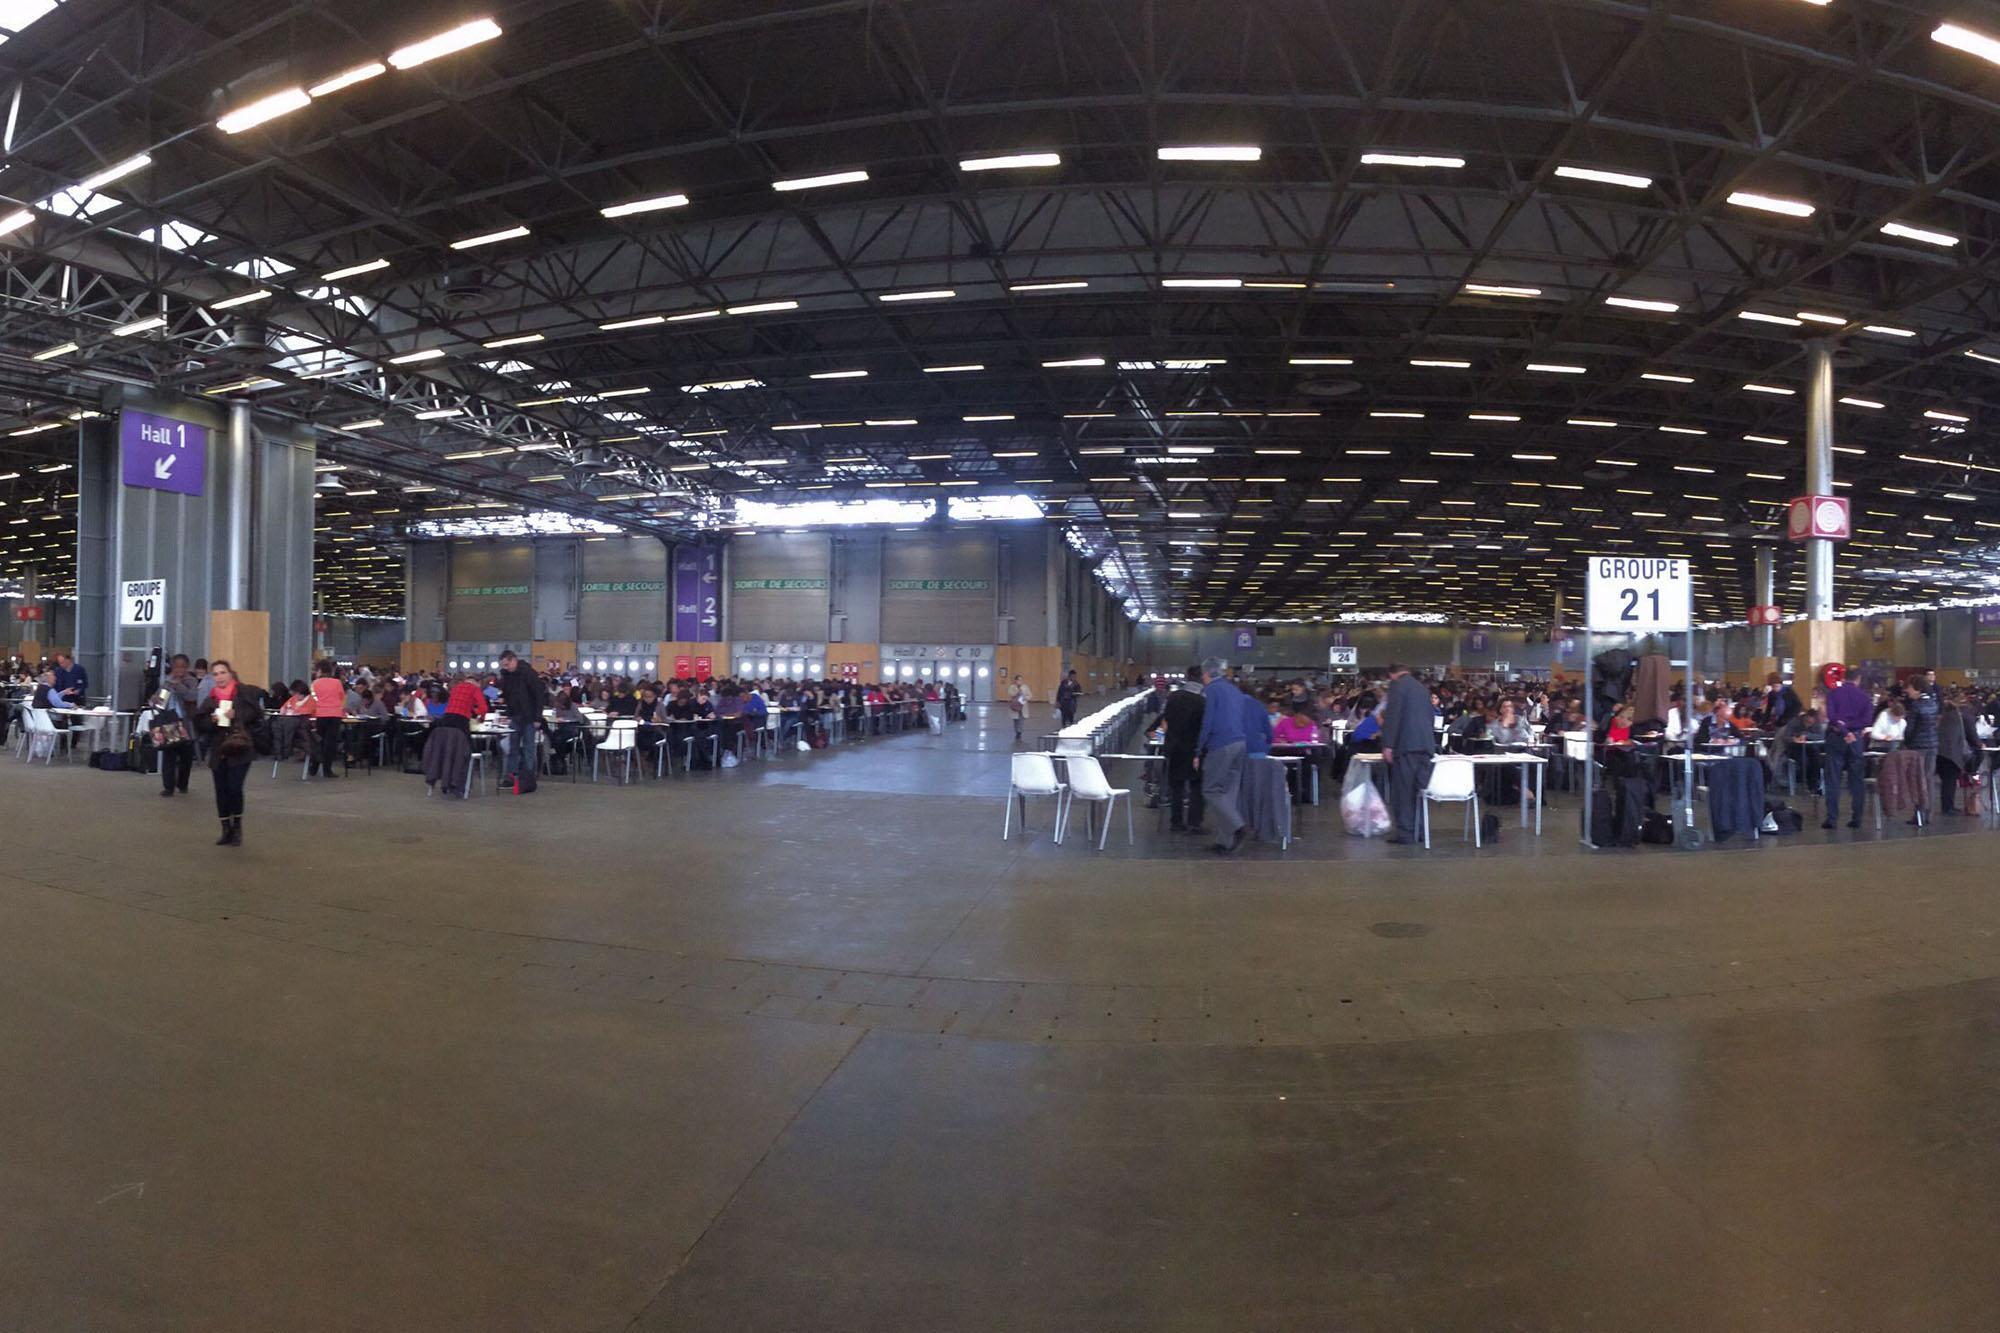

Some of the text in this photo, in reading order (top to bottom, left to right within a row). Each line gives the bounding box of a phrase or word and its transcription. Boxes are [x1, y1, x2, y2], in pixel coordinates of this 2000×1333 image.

[141, 423, 186, 448] Hall 1
[706, 554, 715, 570] 1
[1599, 559, 1679, 580] GROUPE
[127, 581, 161, 598] GROUPE
[582, 582, 665, 591] SORTIE DE SECOURS
[735, 580, 827, 589] SORTIE DE SECOURS
[888, 580, 988, 589] SORTIE DE SECOURS
[134, 599, 154, 622] 20
[678, 597, 716, 614] Hall 2
[1619, 588, 1661, 621] 21
[744, 644, 766, 653] Hall
[768, 644, 776, 653] 2
[790, 644, 798, 653] C
[894, 647, 916, 656] Hall
[919, 647, 927, 657] 2
[955, 647, 963, 657] C
[1337, 654, 1350, 663] 24
